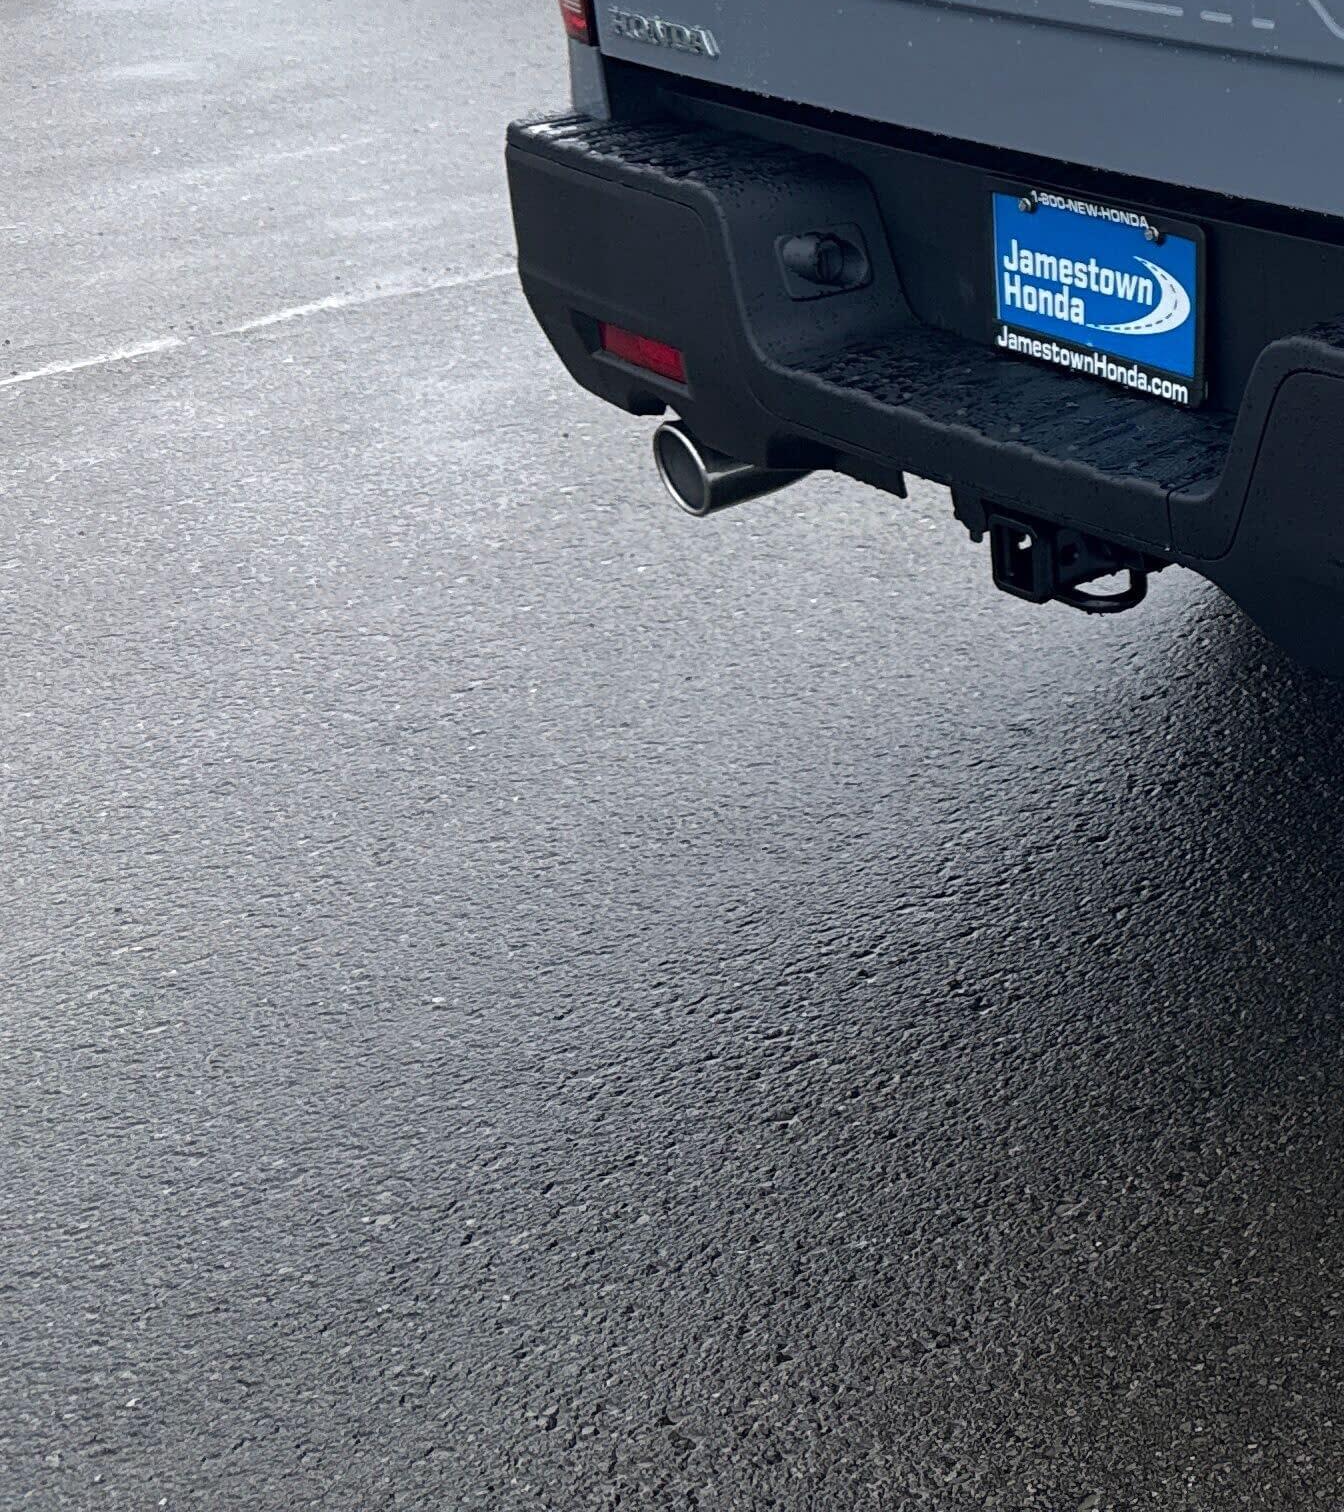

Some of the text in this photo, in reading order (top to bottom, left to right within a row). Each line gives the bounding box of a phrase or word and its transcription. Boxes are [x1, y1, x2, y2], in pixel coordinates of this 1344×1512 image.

[607, 4, 721, 60] HONDA
[1030, 190, 1150, 230] 1-800-NEW-HONDA
[1003, 238, 1154, 306] Jamestown
[1003, 271, 1085, 326] Honda
[997, 325, 1189, 405] JamestownHonda.com
